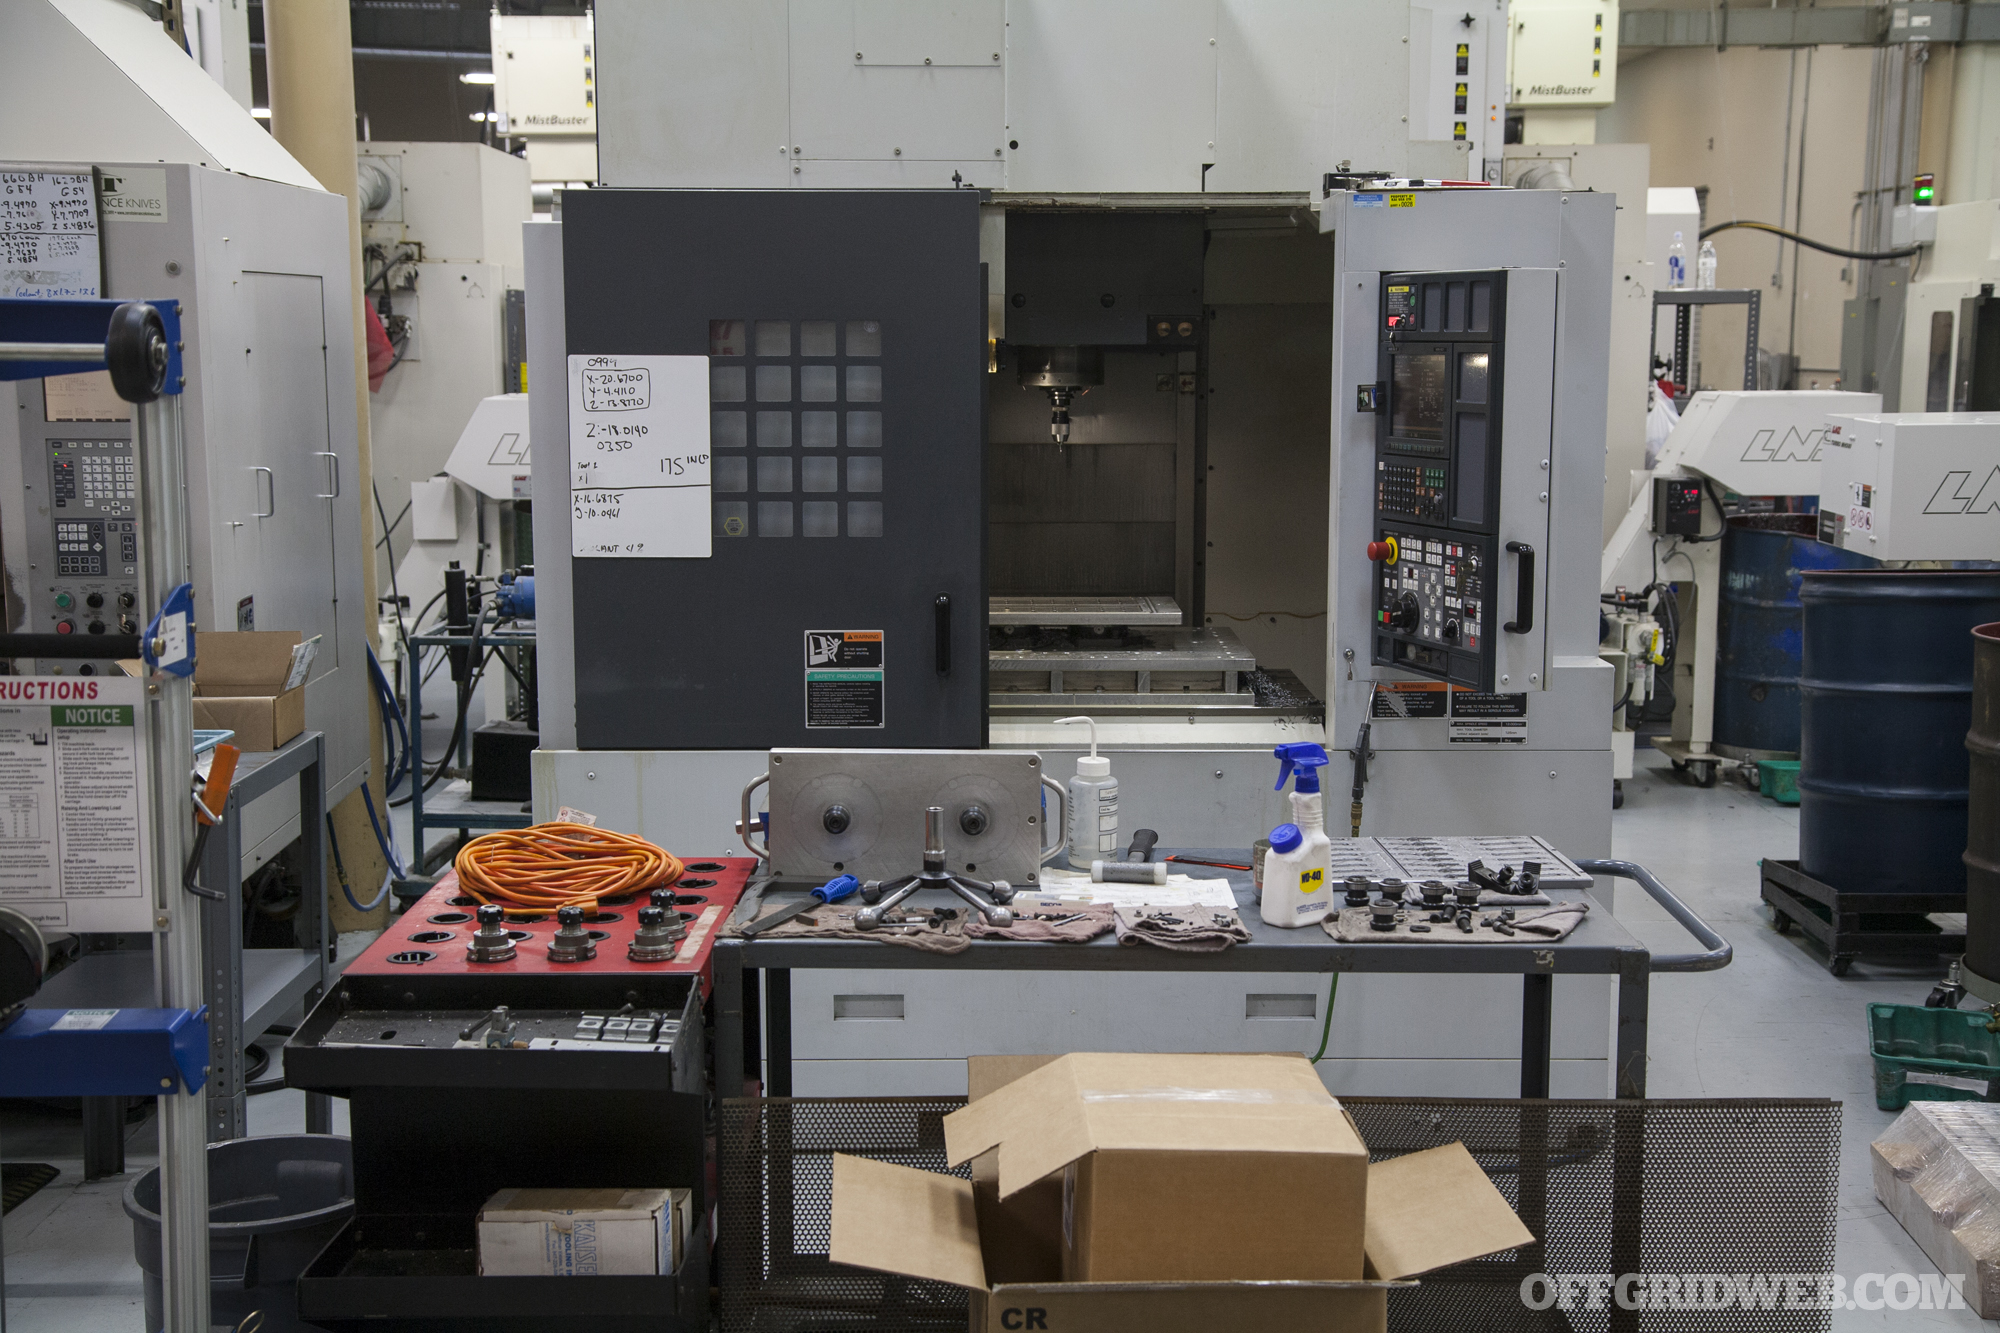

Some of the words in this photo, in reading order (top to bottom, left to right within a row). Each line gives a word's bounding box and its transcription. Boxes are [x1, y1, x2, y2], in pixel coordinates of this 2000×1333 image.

[1529, 85, 1596, 96] MistBuster
[525, 115, 590, 126] MistBuster
[126, 198, 161, 209] KNIVES
[661, 457, 685, 475] 175
[65, 708, 120, 723] NOTICE
[1301, 870, 1321, 884] WD-40
[574, 1220, 597, 1276] KAISE
[1001, 1307, 1048, 1330] CR
